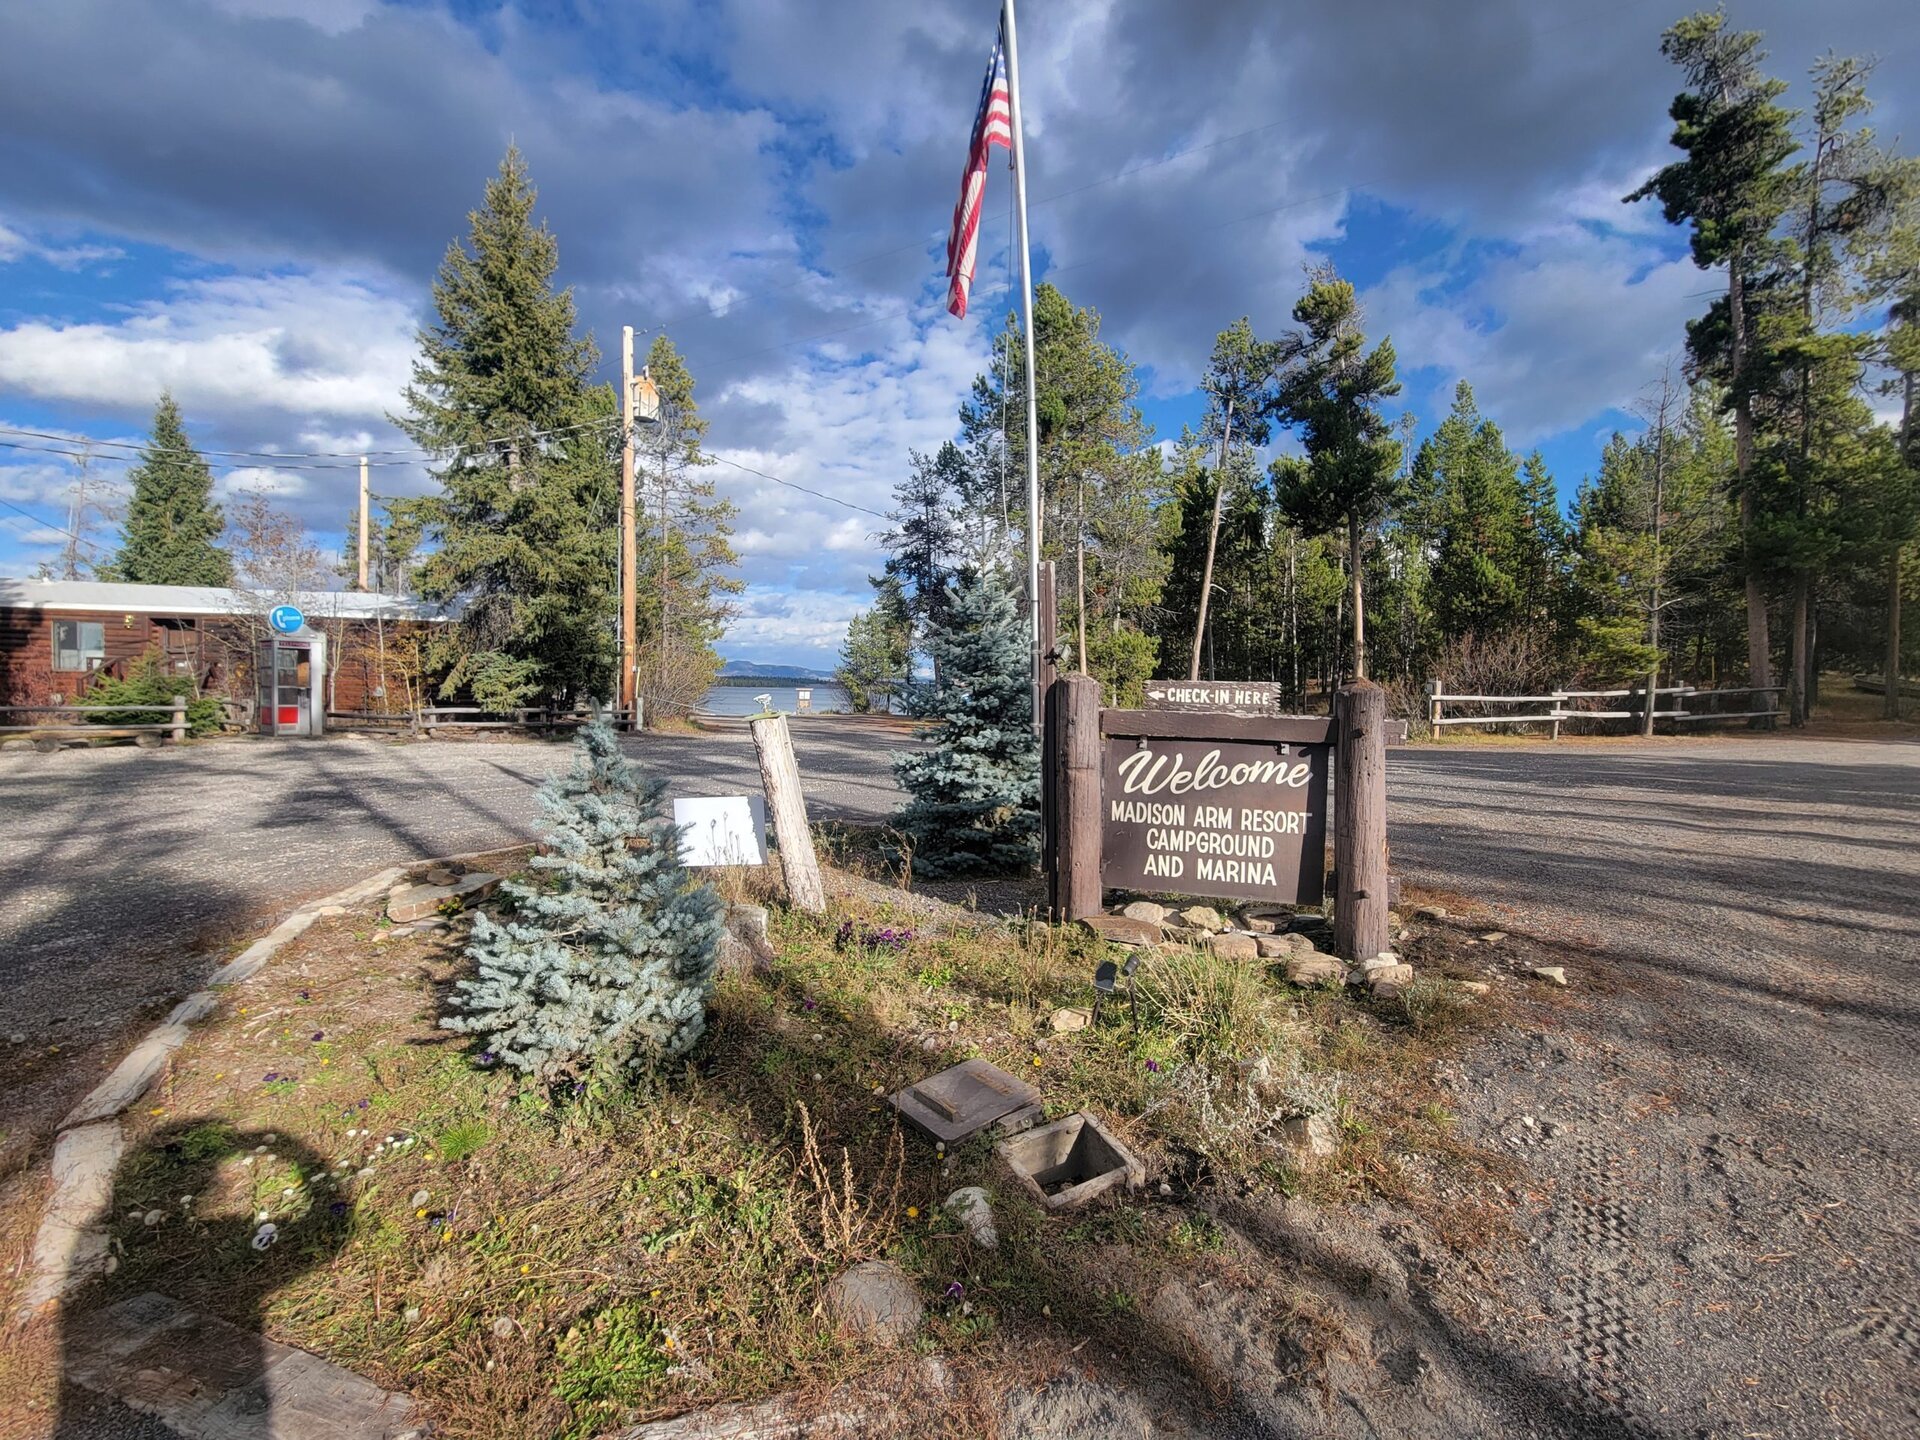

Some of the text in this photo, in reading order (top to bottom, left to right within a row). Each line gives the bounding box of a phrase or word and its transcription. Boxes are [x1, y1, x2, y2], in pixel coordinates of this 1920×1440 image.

[1167, 687, 1270, 705] CHECK-IN HERE
[1118, 750, 1313, 795] Welcome
[1111, 800, 1313, 834] MADISON ARM RESORT
[1146, 828, 1275, 858] CAMPGROUND
[1144, 854, 1277, 886] AND MARINA
